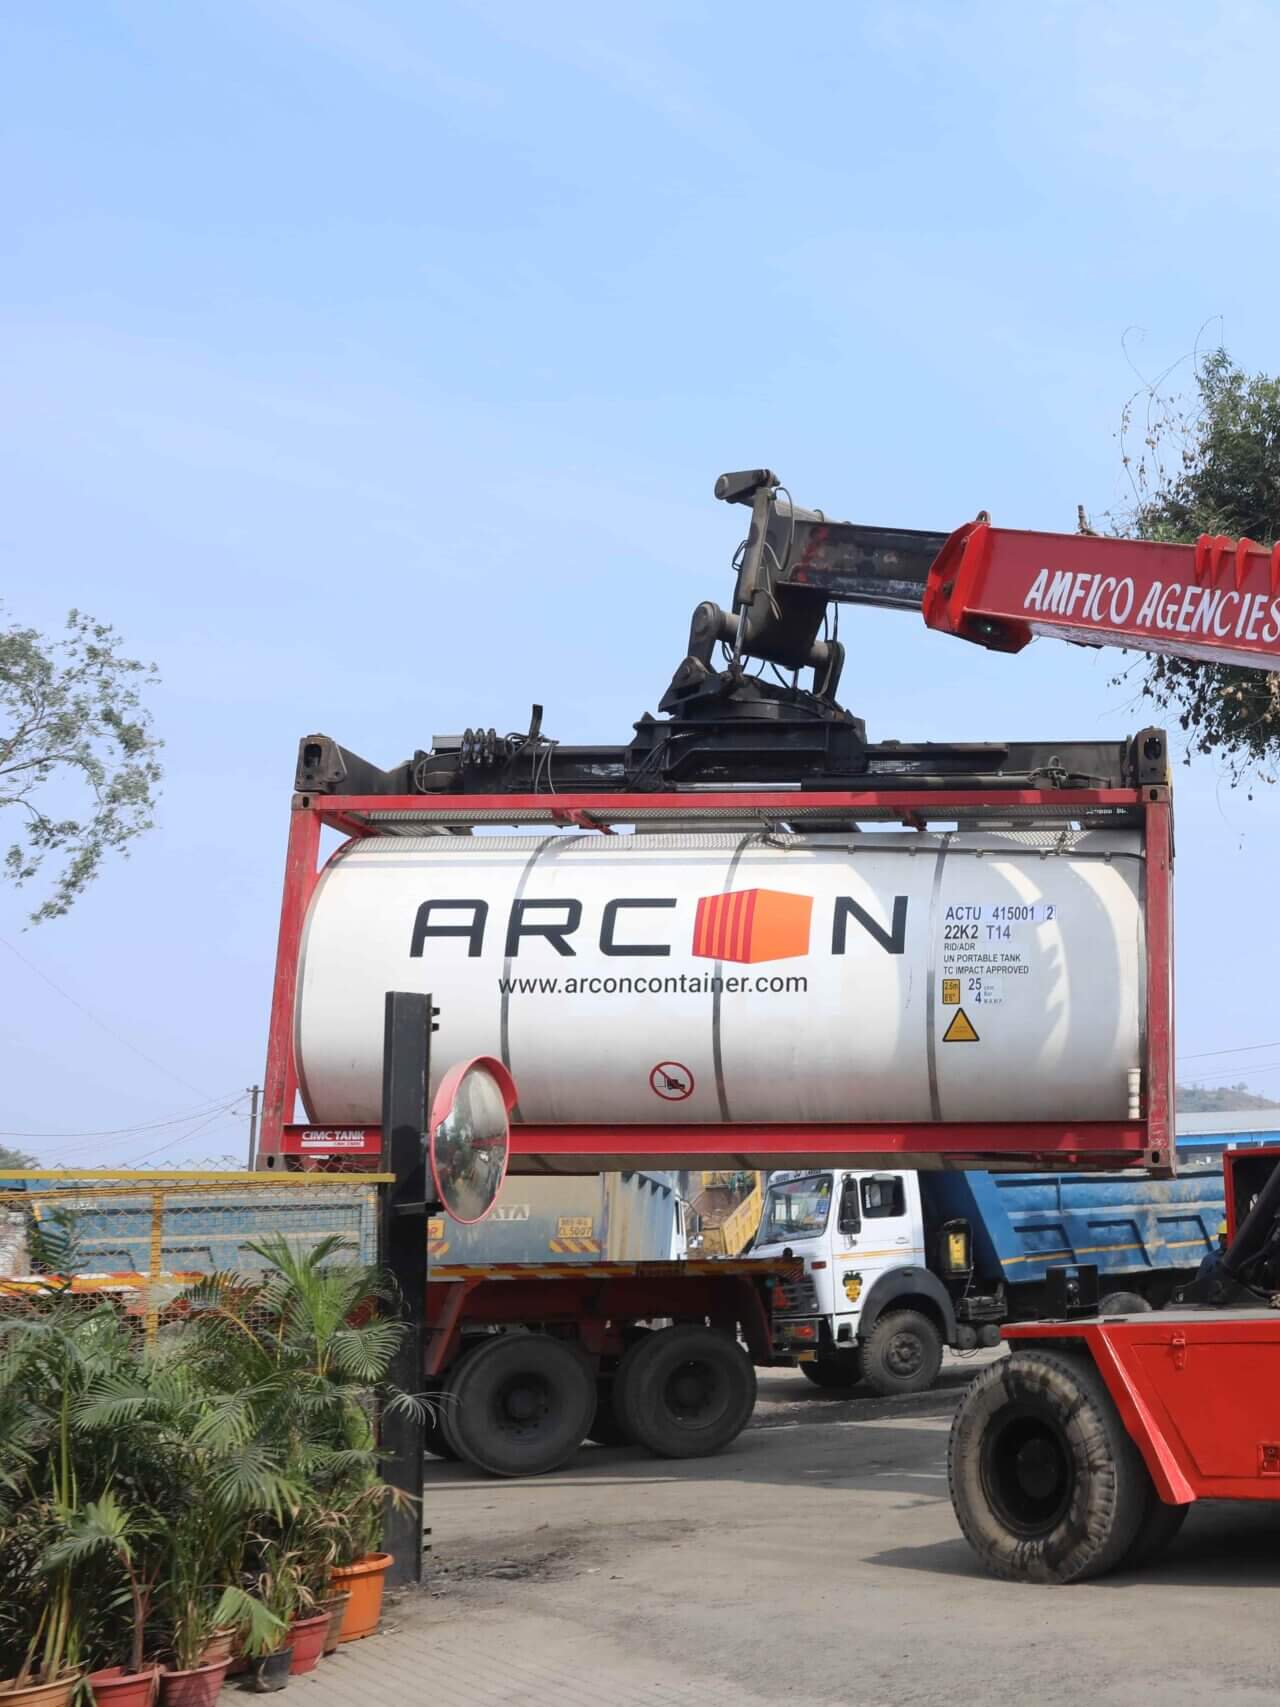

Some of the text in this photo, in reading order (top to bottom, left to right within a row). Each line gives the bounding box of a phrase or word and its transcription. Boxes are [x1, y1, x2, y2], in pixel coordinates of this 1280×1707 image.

[1023, 568, 1135, 624] AMFICO
[945, 906, 1055, 920] ACTU 415001 2
[944, 924, 1011, 939] 22K2 T14
[944, 942, 975, 951] RID/ADR
[944, 954, 1021, 962] UN PORTABLE TANK
[944, 966, 1029, 974] TC IMPACT APPROVED
[499, 972, 808, 995] www.arconcontainer.com
[968, 978, 982, 990] 25
[975, 992, 982, 1004] 4
[302, 1131, 365, 1140] CIMC TANK
